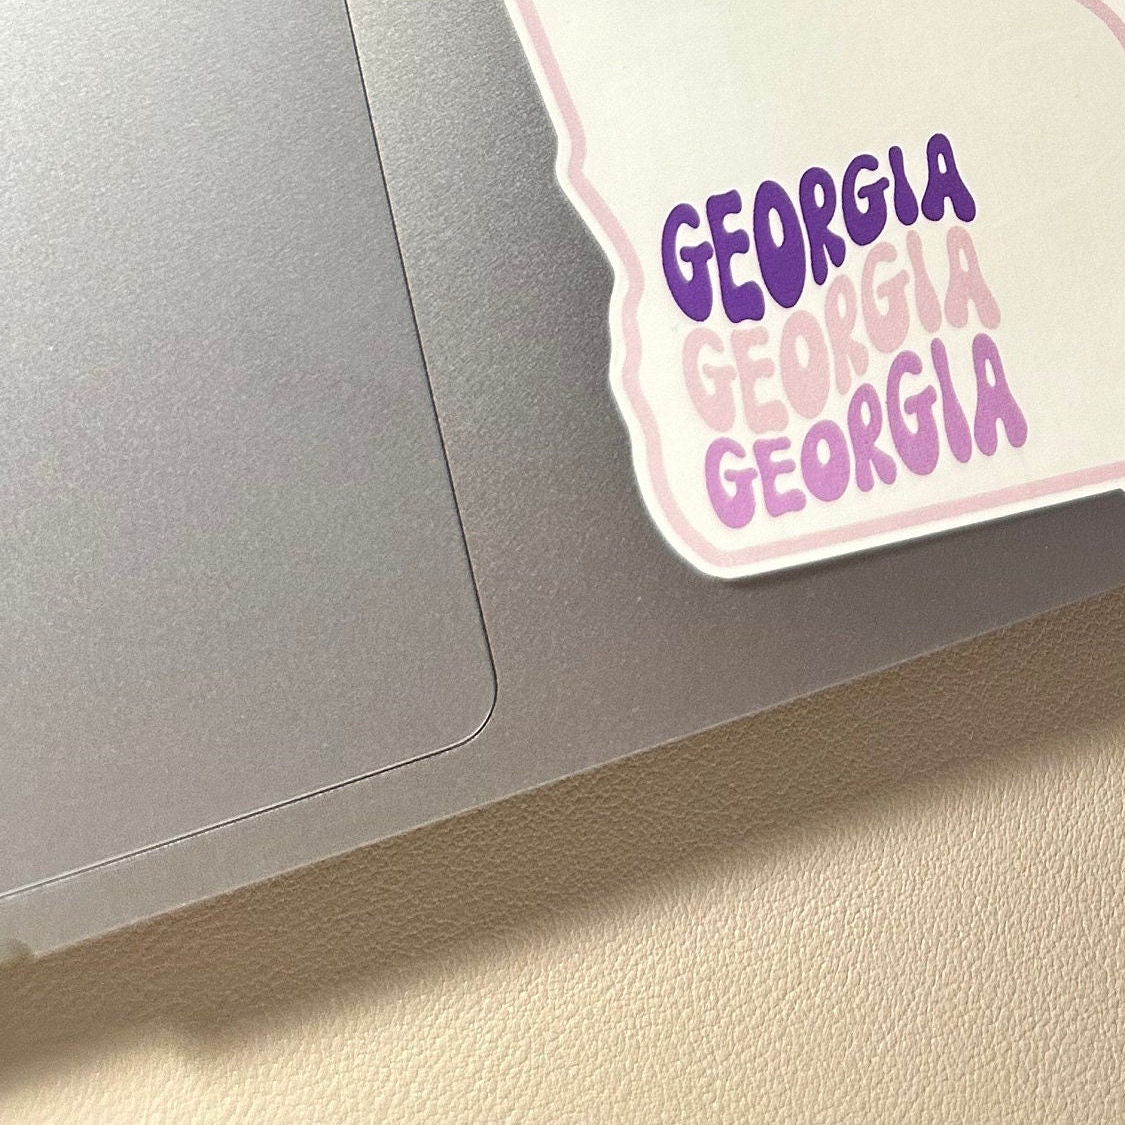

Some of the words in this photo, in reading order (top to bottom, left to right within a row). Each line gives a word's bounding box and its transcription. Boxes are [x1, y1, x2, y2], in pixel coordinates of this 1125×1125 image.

[662, 133, 976, 323] GEORGIA
[682, 226, 1001, 434] GEORGIA
[705, 332, 1028, 529] GEORGIA
